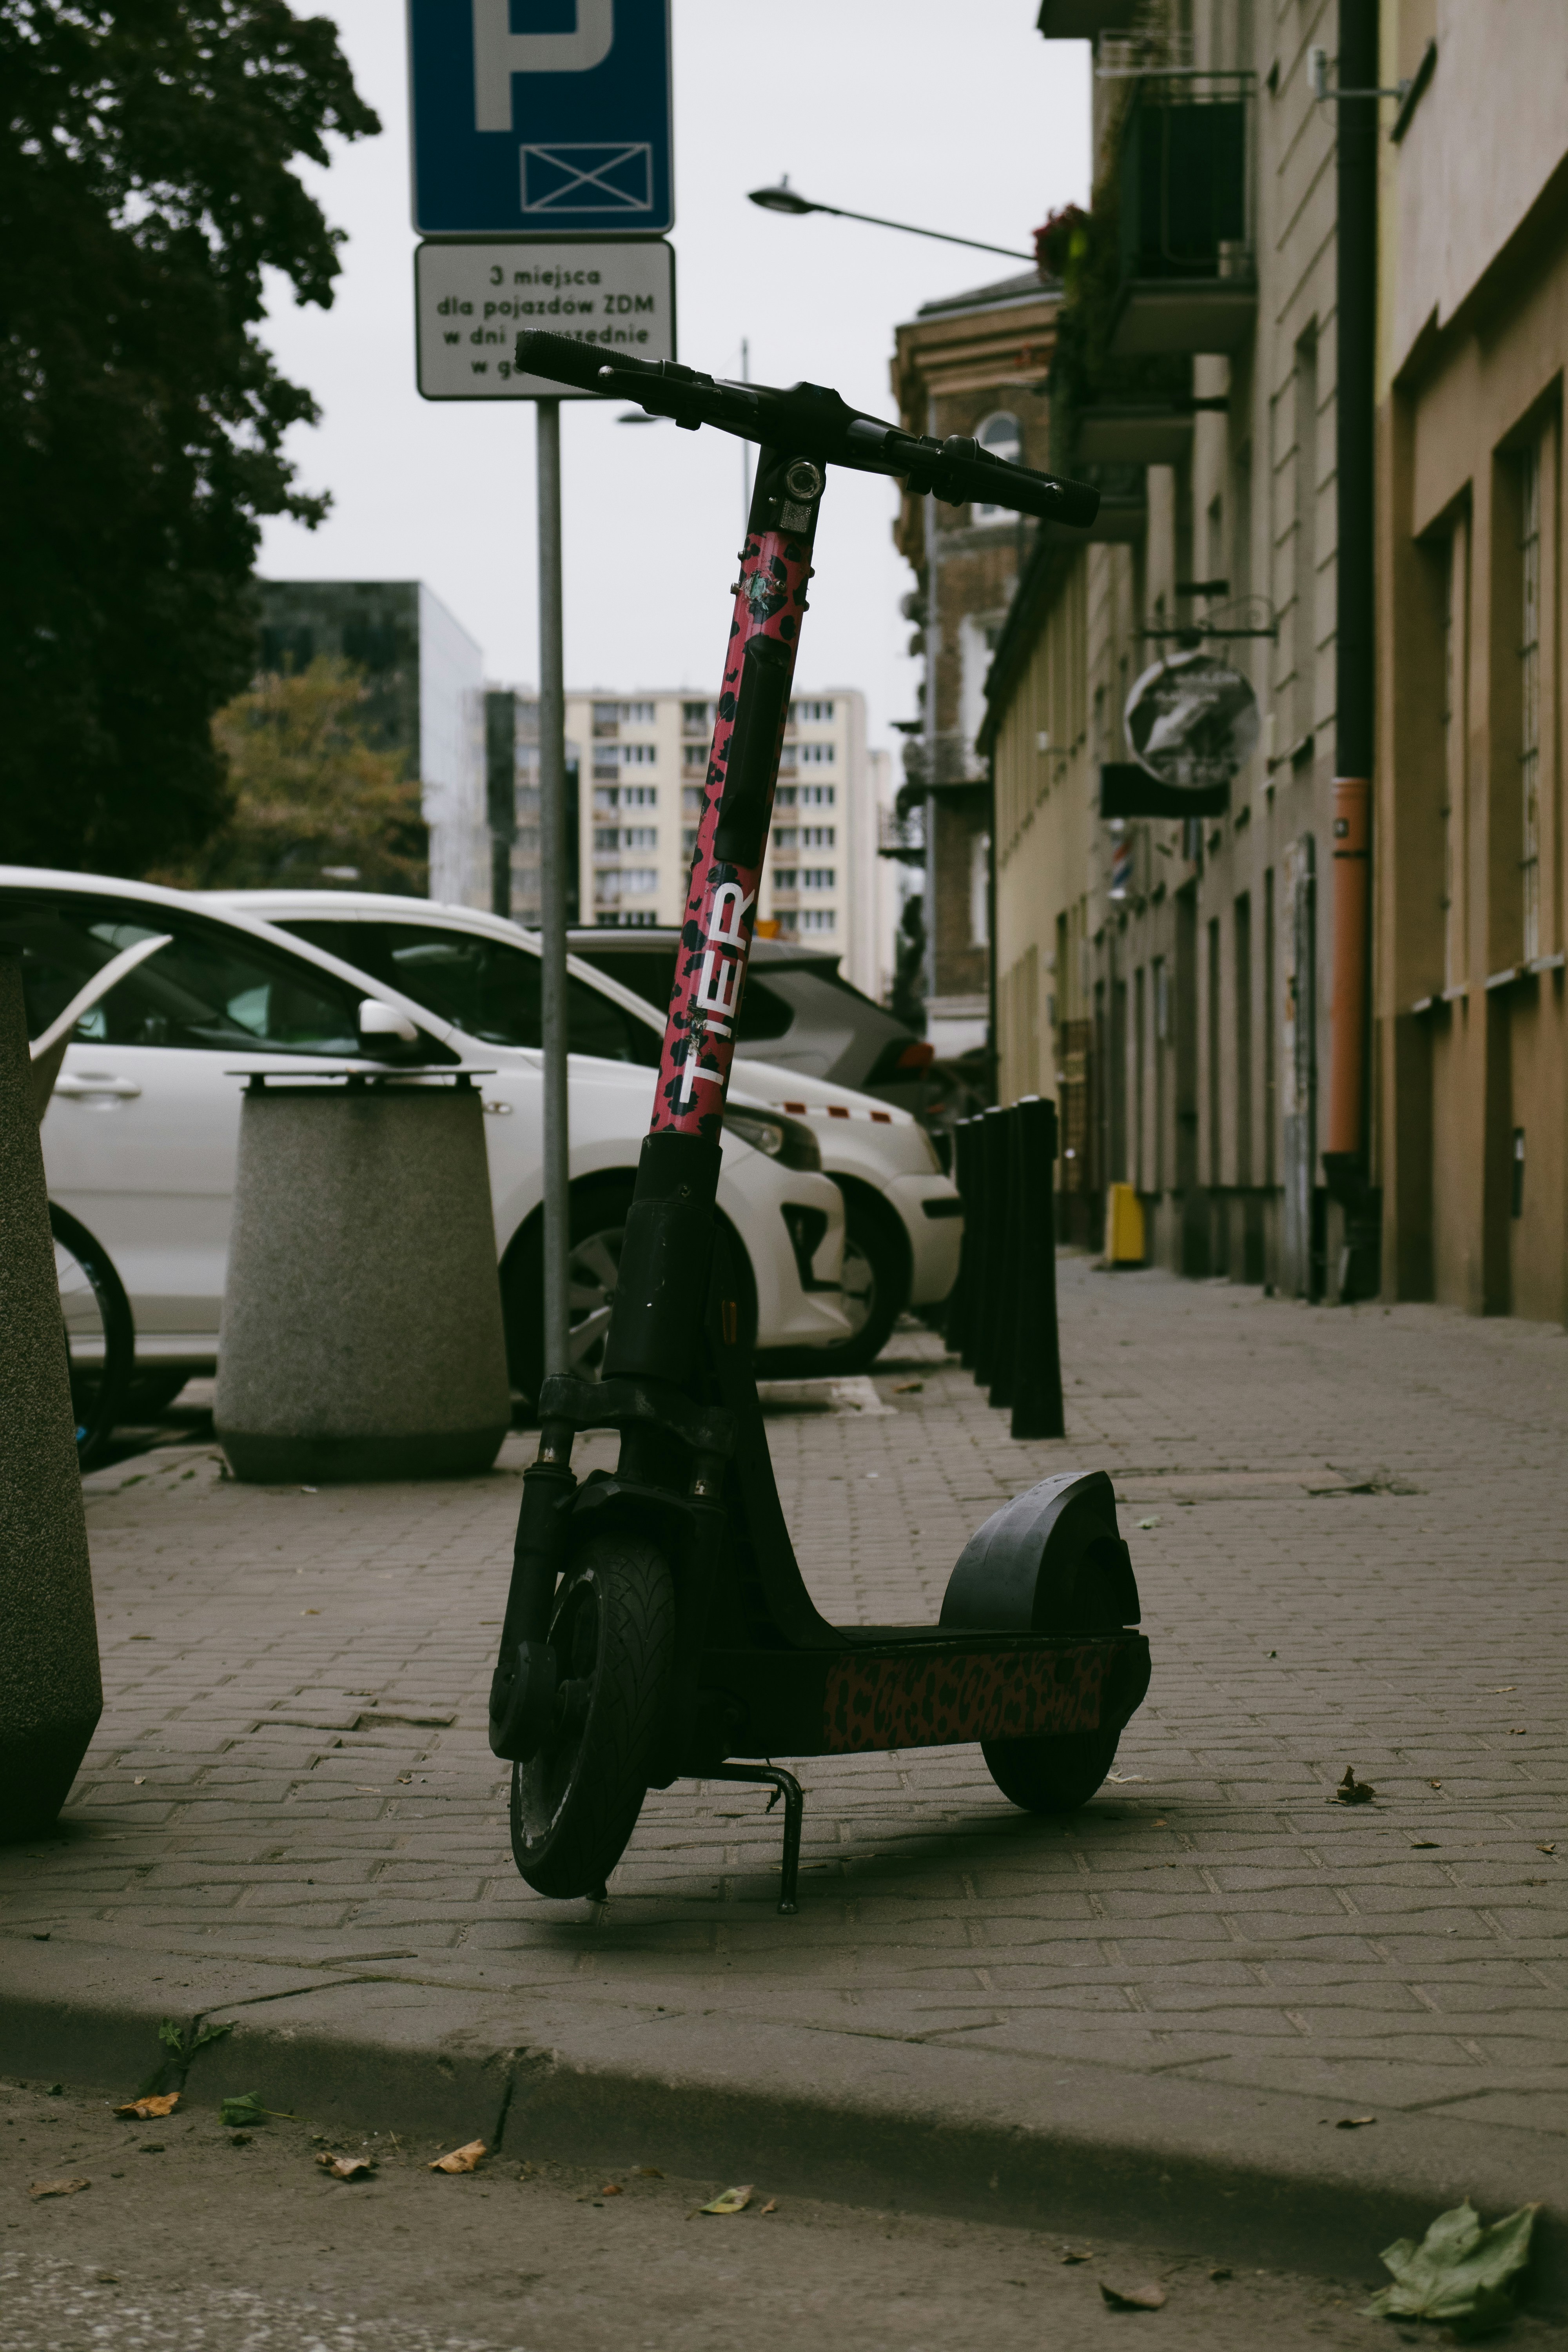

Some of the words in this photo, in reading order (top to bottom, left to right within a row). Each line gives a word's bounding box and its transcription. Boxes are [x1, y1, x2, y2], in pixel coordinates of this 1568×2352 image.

[472, 0, 616, 133] P
[490, 265, 504, 285] 3
[514, 265, 601, 289] miejsca
[437, 296, 473, 315] dla
[484, 294, 593, 319] pojazdów
[604, 294, 655, 313] ZDM
[443, 330, 460, 344] w
[470, 325, 506, 344] dni
[472, 361, 487, 374] w
[679, 882, 755, 1103] TIER
